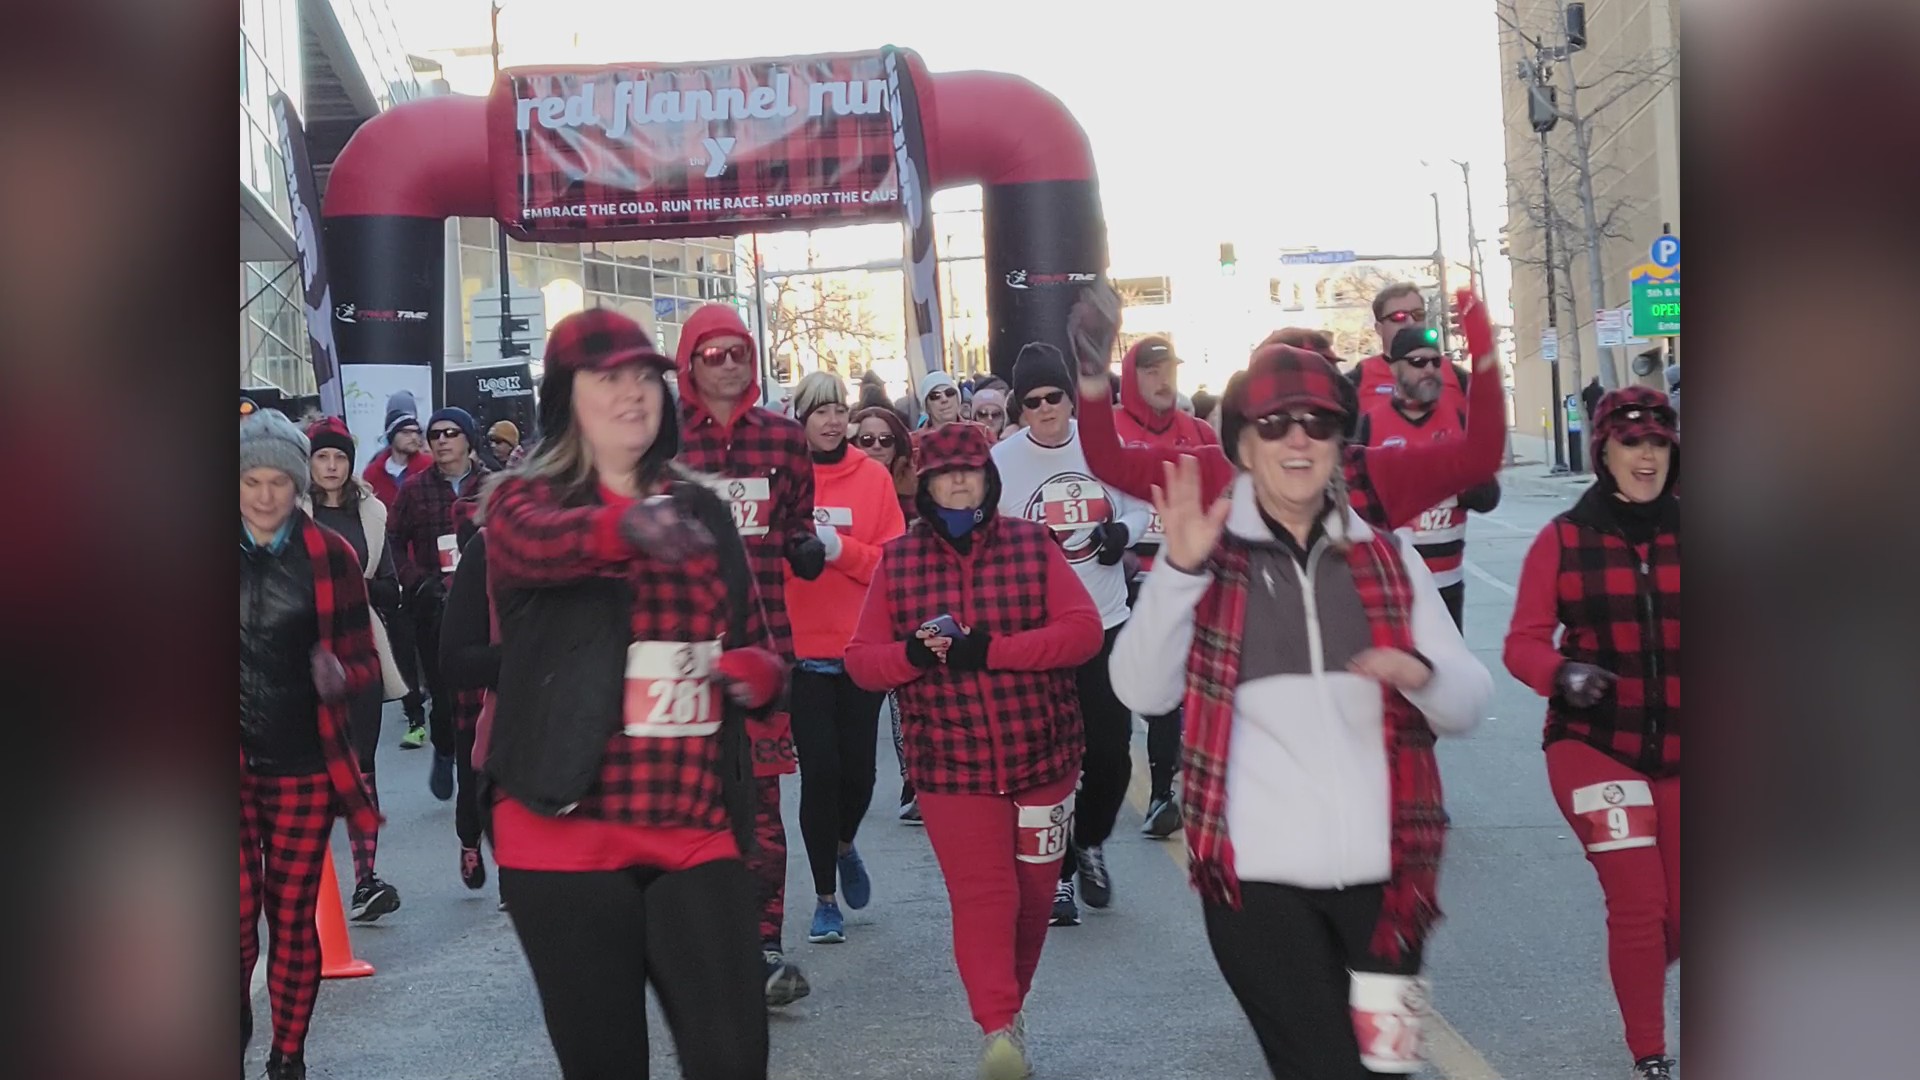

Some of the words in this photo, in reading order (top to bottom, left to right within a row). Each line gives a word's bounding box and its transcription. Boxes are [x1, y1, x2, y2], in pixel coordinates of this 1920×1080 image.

[517, 83, 599, 129] red
[606, 74, 797, 138] flannel
[808, 79, 891, 116] run
[522, 205, 587, 219] EMBRACE
[589, 203, 617, 216] THE
[619, 202, 658, 215] COLD.
[661, 200, 691, 212] RUN
[694, 198, 721, 210] THE
[723, 196, 764, 210] RACE.
[766, 193, 830, 207] SUPPORT
[832, 191, 859, 203] THE
[1660, 239, 1677, 264] P
[478, 376, 521, 391] LOOK
[1063, 499, 1089, 524] 51
[1419, 508, 1453, 531] 422
[646, 678, 711, 725] 281
[1607, 807, 1630, 840] 9
